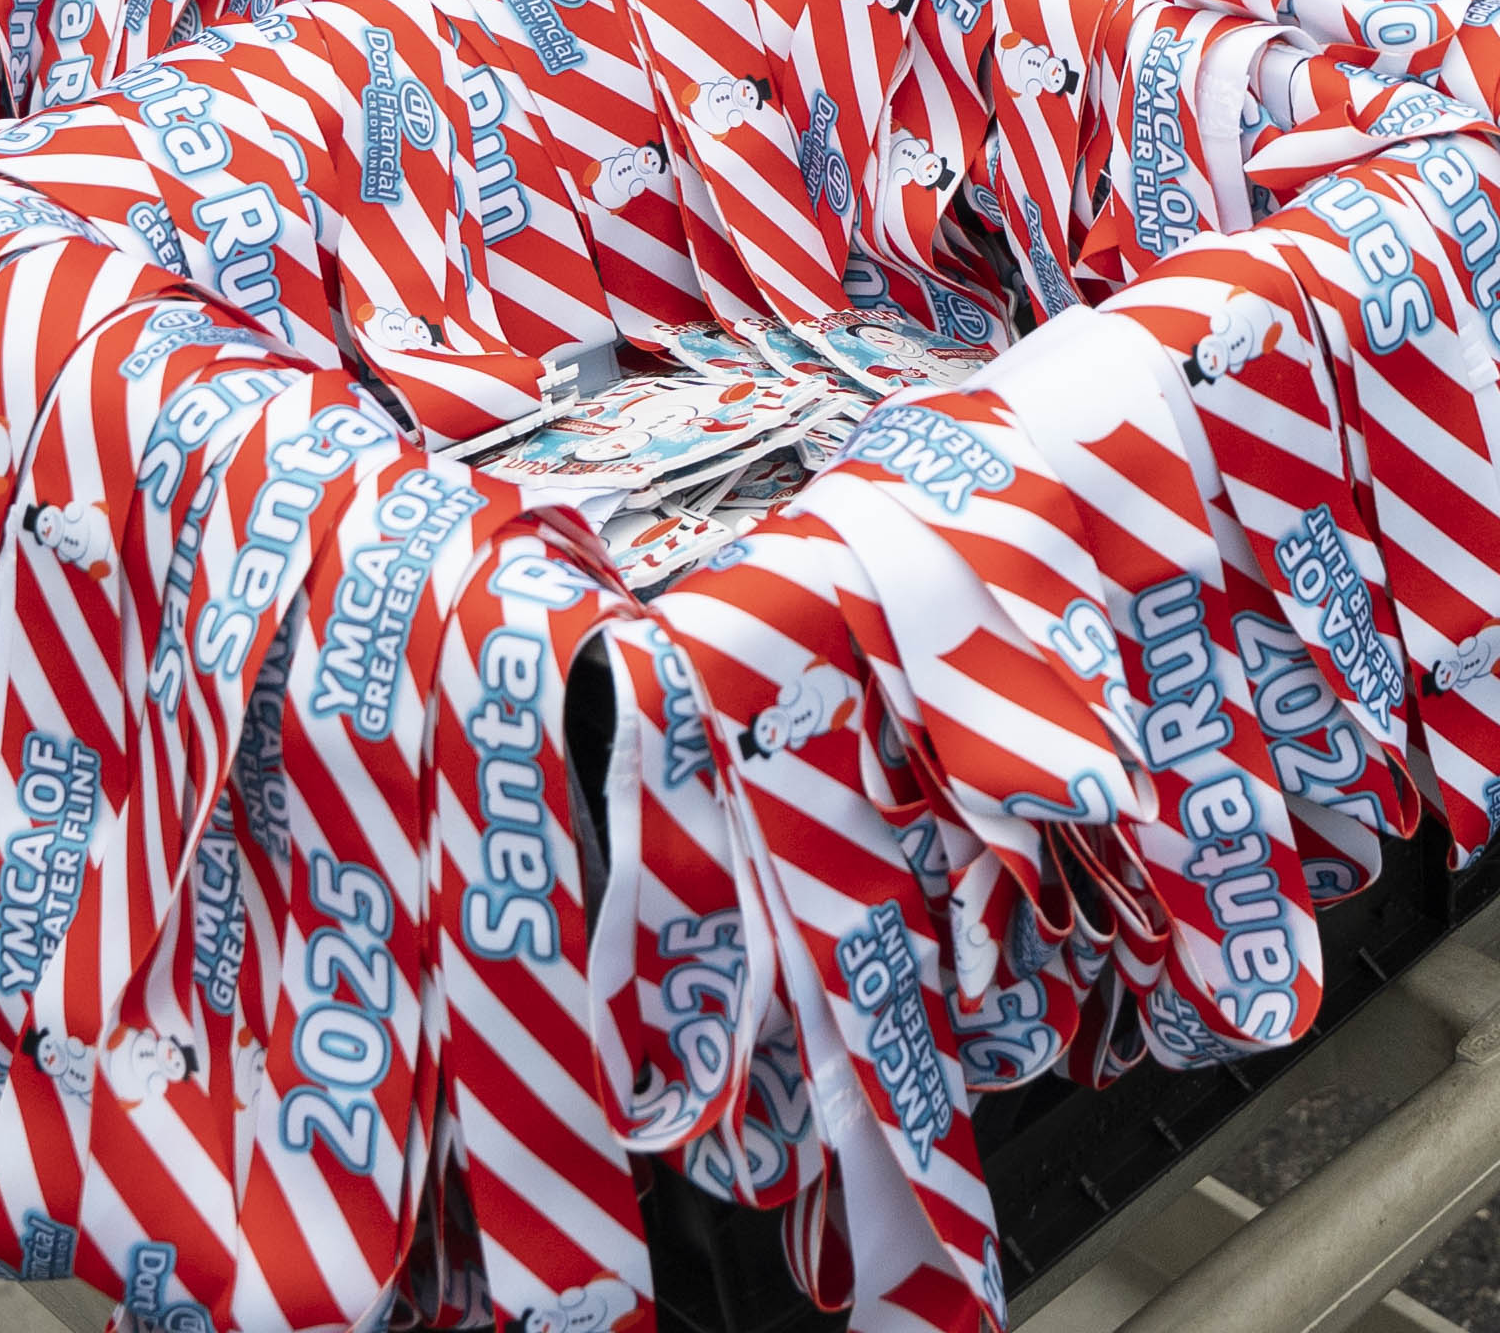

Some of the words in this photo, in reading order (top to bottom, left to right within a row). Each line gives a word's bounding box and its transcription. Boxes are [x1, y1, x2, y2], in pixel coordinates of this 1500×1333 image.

[366, 33, 393, 92] Dort
[532, 28, 559, 70] UNION
[368, 90, 380, 146] CREDIT
[399, 81, 435, 148] df
[814, 95, 835, 135] Dort
[1133, 30, 1173, 163] GREATER
[1155, 38, 1196, 182] YMCA
[365, 149, 377, 197] UNION
[379, 94, 399, 200] Financial
[824, 156, 851, 214] df
[1135, 167, 1163, 253] FLINT
[946, 296, 988, 342] df
[203, 407, 377, 677] Santa
[1279, 538, 1326, 601] OF
[1307, 507, 1355, 590] FLINT
[318, 547, 399, 713] YMCA
[381, 473, 444, 529] OF
[361, 561, 420, 734] GREATER
[409, 489, 483, 564] FLINT
[1137, 580, 1231, 768] Run
[1323, 598, 1391, 728] YMCA
[1345, 588, 1403, 707] GREATER
[26, 739, 68, 815] OF
[70, 751, 97, 840] FLINT
[467, 632, 557, 961] Santa
[2, 838, 52, 991] YMCA
[873, 909, 912, 1005] FLINT
[283, 856, 391, 1174] 2025
[841, 935, 889, 1011] OF
[1155, 990, 1193, 1054] OF
[869, 1013, 932, 1167] YMCA
[898, 1010, 951, 1135] GREATER
[136, 1249, 169, 1305] Dort
